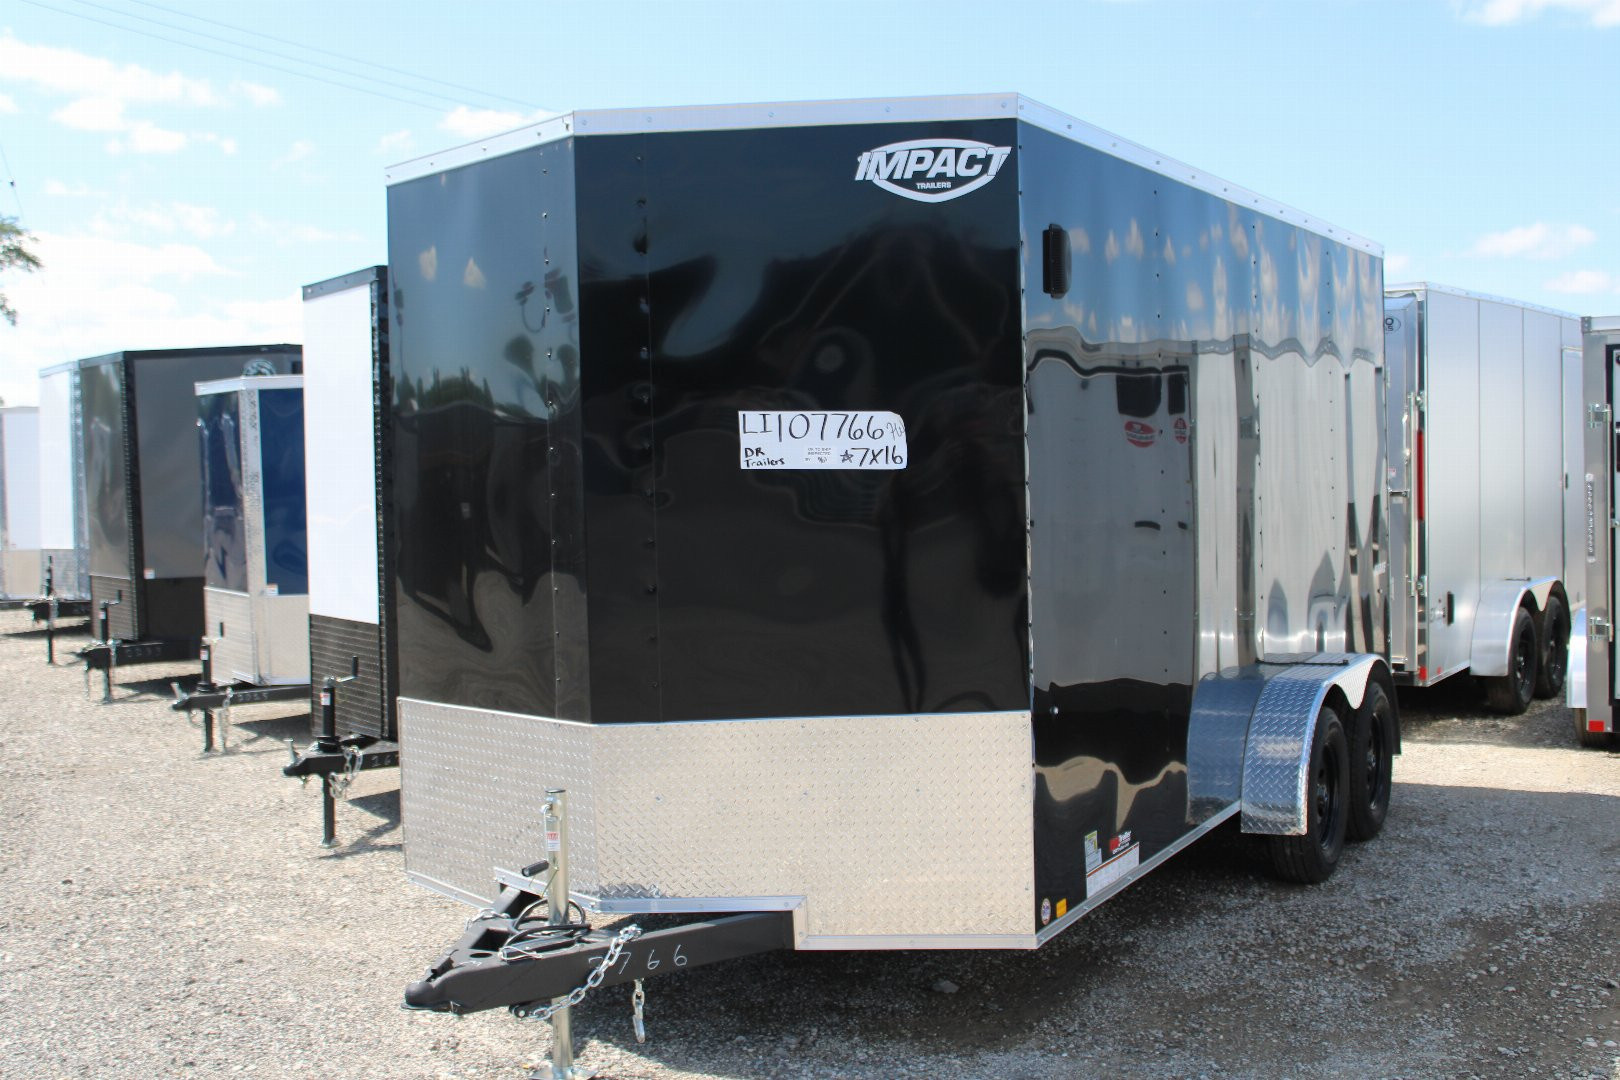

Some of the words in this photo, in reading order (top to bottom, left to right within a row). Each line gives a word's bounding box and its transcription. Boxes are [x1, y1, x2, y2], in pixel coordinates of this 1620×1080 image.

[855, 146, 1012, 181] IMPACT
[916, 182, 952, 190] TRAILERS
[744, 447, 765, 458] DR
[744, 457, 785, 468] Trailers
